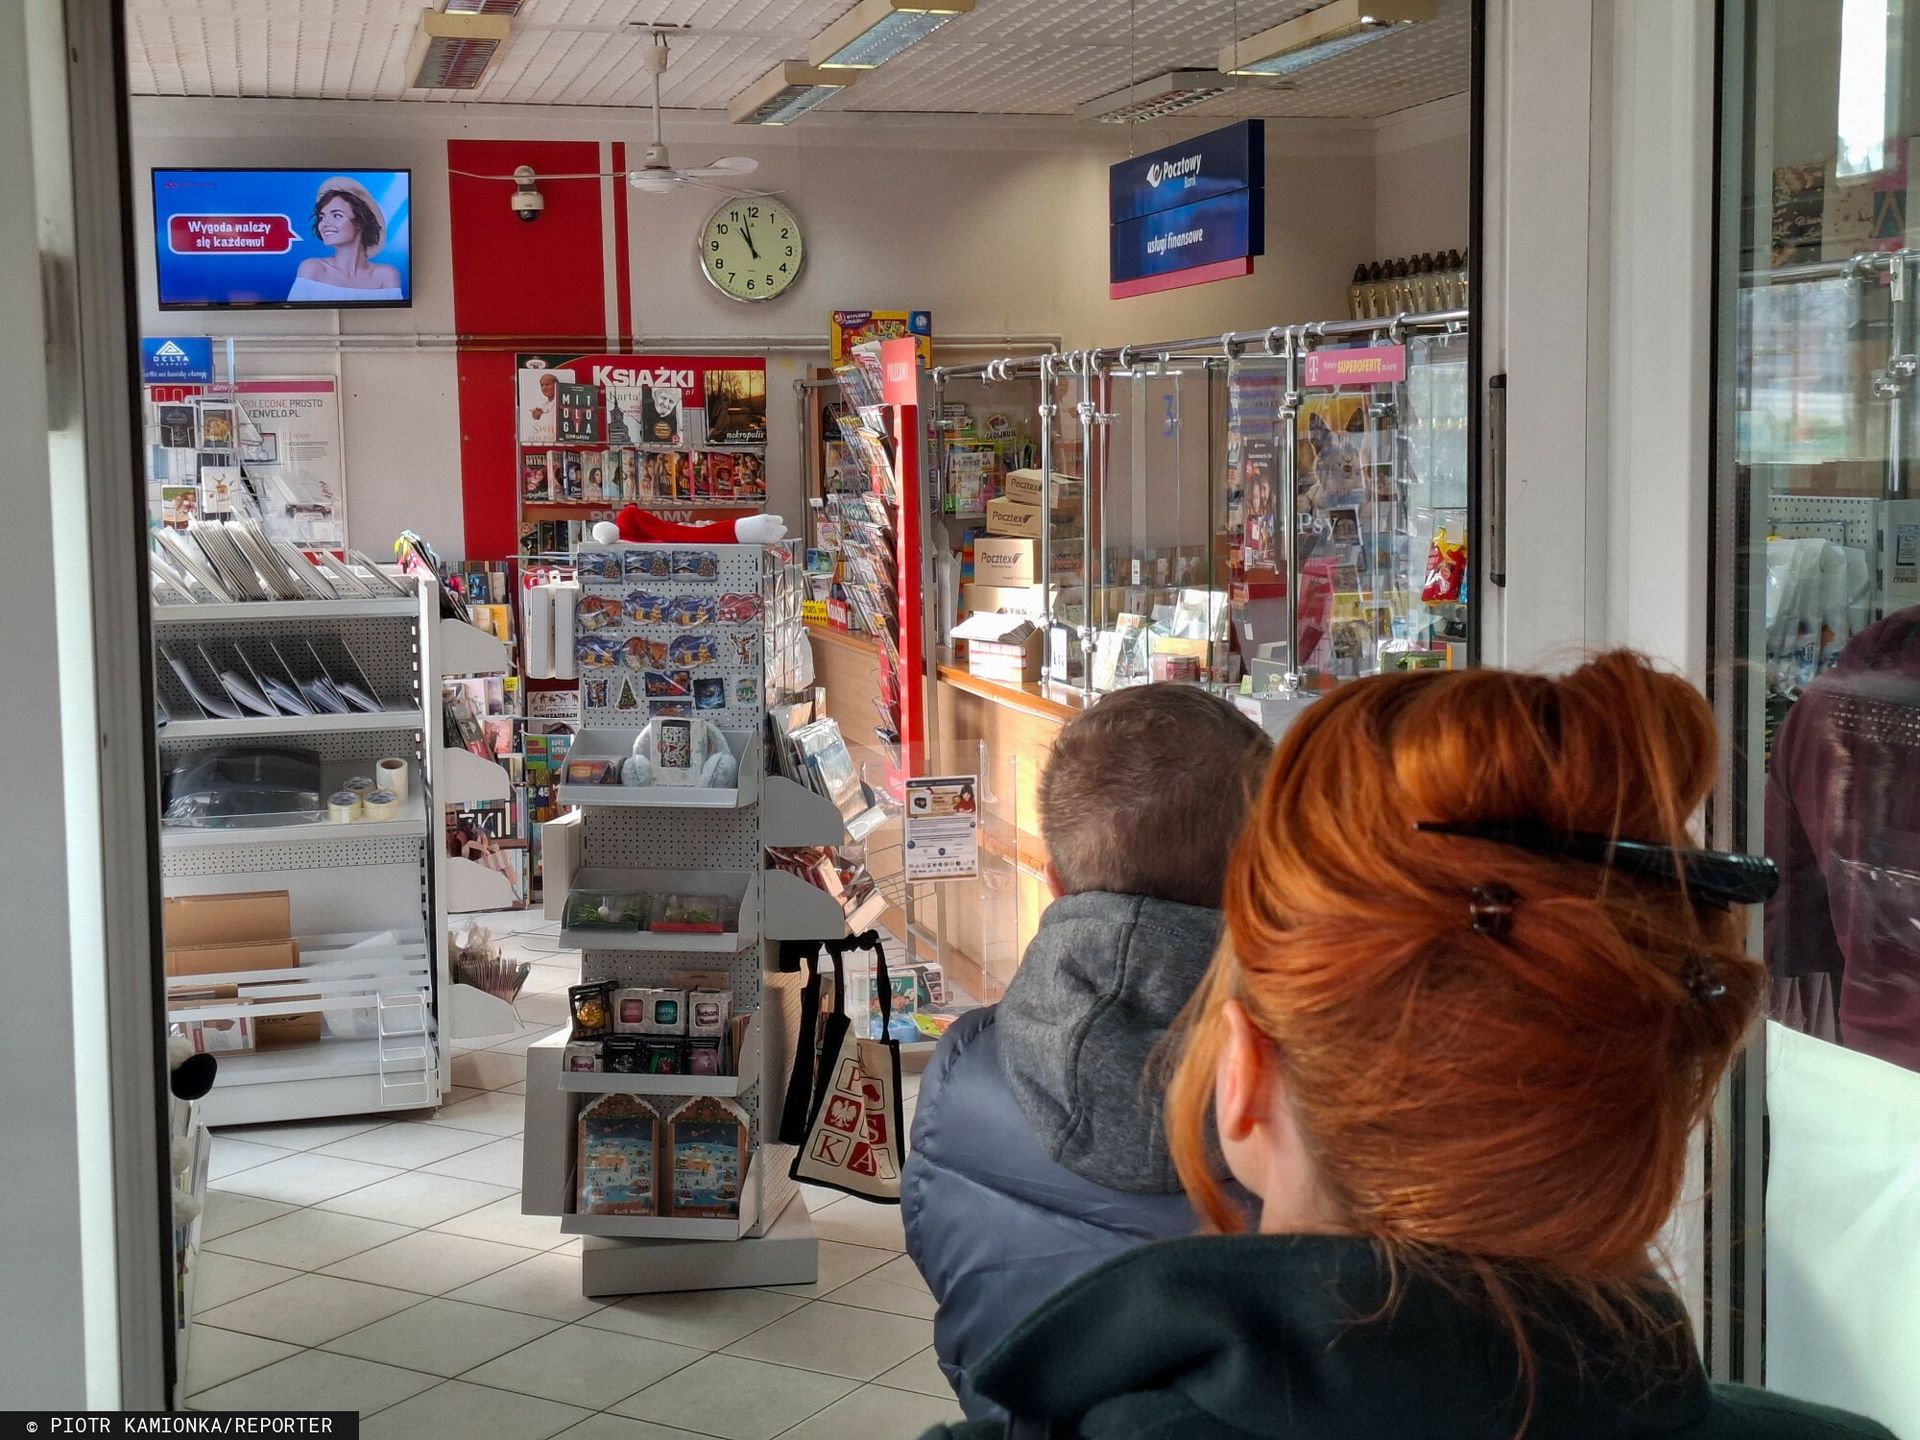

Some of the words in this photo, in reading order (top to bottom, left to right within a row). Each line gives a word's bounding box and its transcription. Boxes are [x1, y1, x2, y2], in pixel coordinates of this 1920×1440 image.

[1162, 154, 1202, 180] Pocztowy
[1184, 174, 1197, 189] Bank
[730, 211, 739, 222] 11
[747, 206, 759, 218] 12
[769, 213, 775, 224] 1
[188, 221, 233, 234] Wygoda
[235, 221, 271, 235] należy
[716, 223, 728, 235] 10
[780, 228, 789, 239] 2
[196, 236, 211, 249] się
[213, 236, 265, 248] każdemu!
[711, 241, 719, 251] 9
[1147, 231, 1167, 255] usługi
[1167, 228, 1204, 247] finansowe
[784, 246, 793, 257] 3
[715, 258, 723, 269] 8
[779, 262, 787, 273] 4
[728, 272, 736, 283] 7
[766, 275, 774, 286] 5
[747, 279, 755, 290] 6
[1337, 358, 1382, 375] SUPEROFERTĘ
[289, 399, 323, 408] PROSTO
[726, 429, 764, 441] nekropolis
[1010, 478, 1038, 492] Pocztex
[992, 511, 1023, 522] Pocztex
[981, 552, 1012, 564] Pocztex
